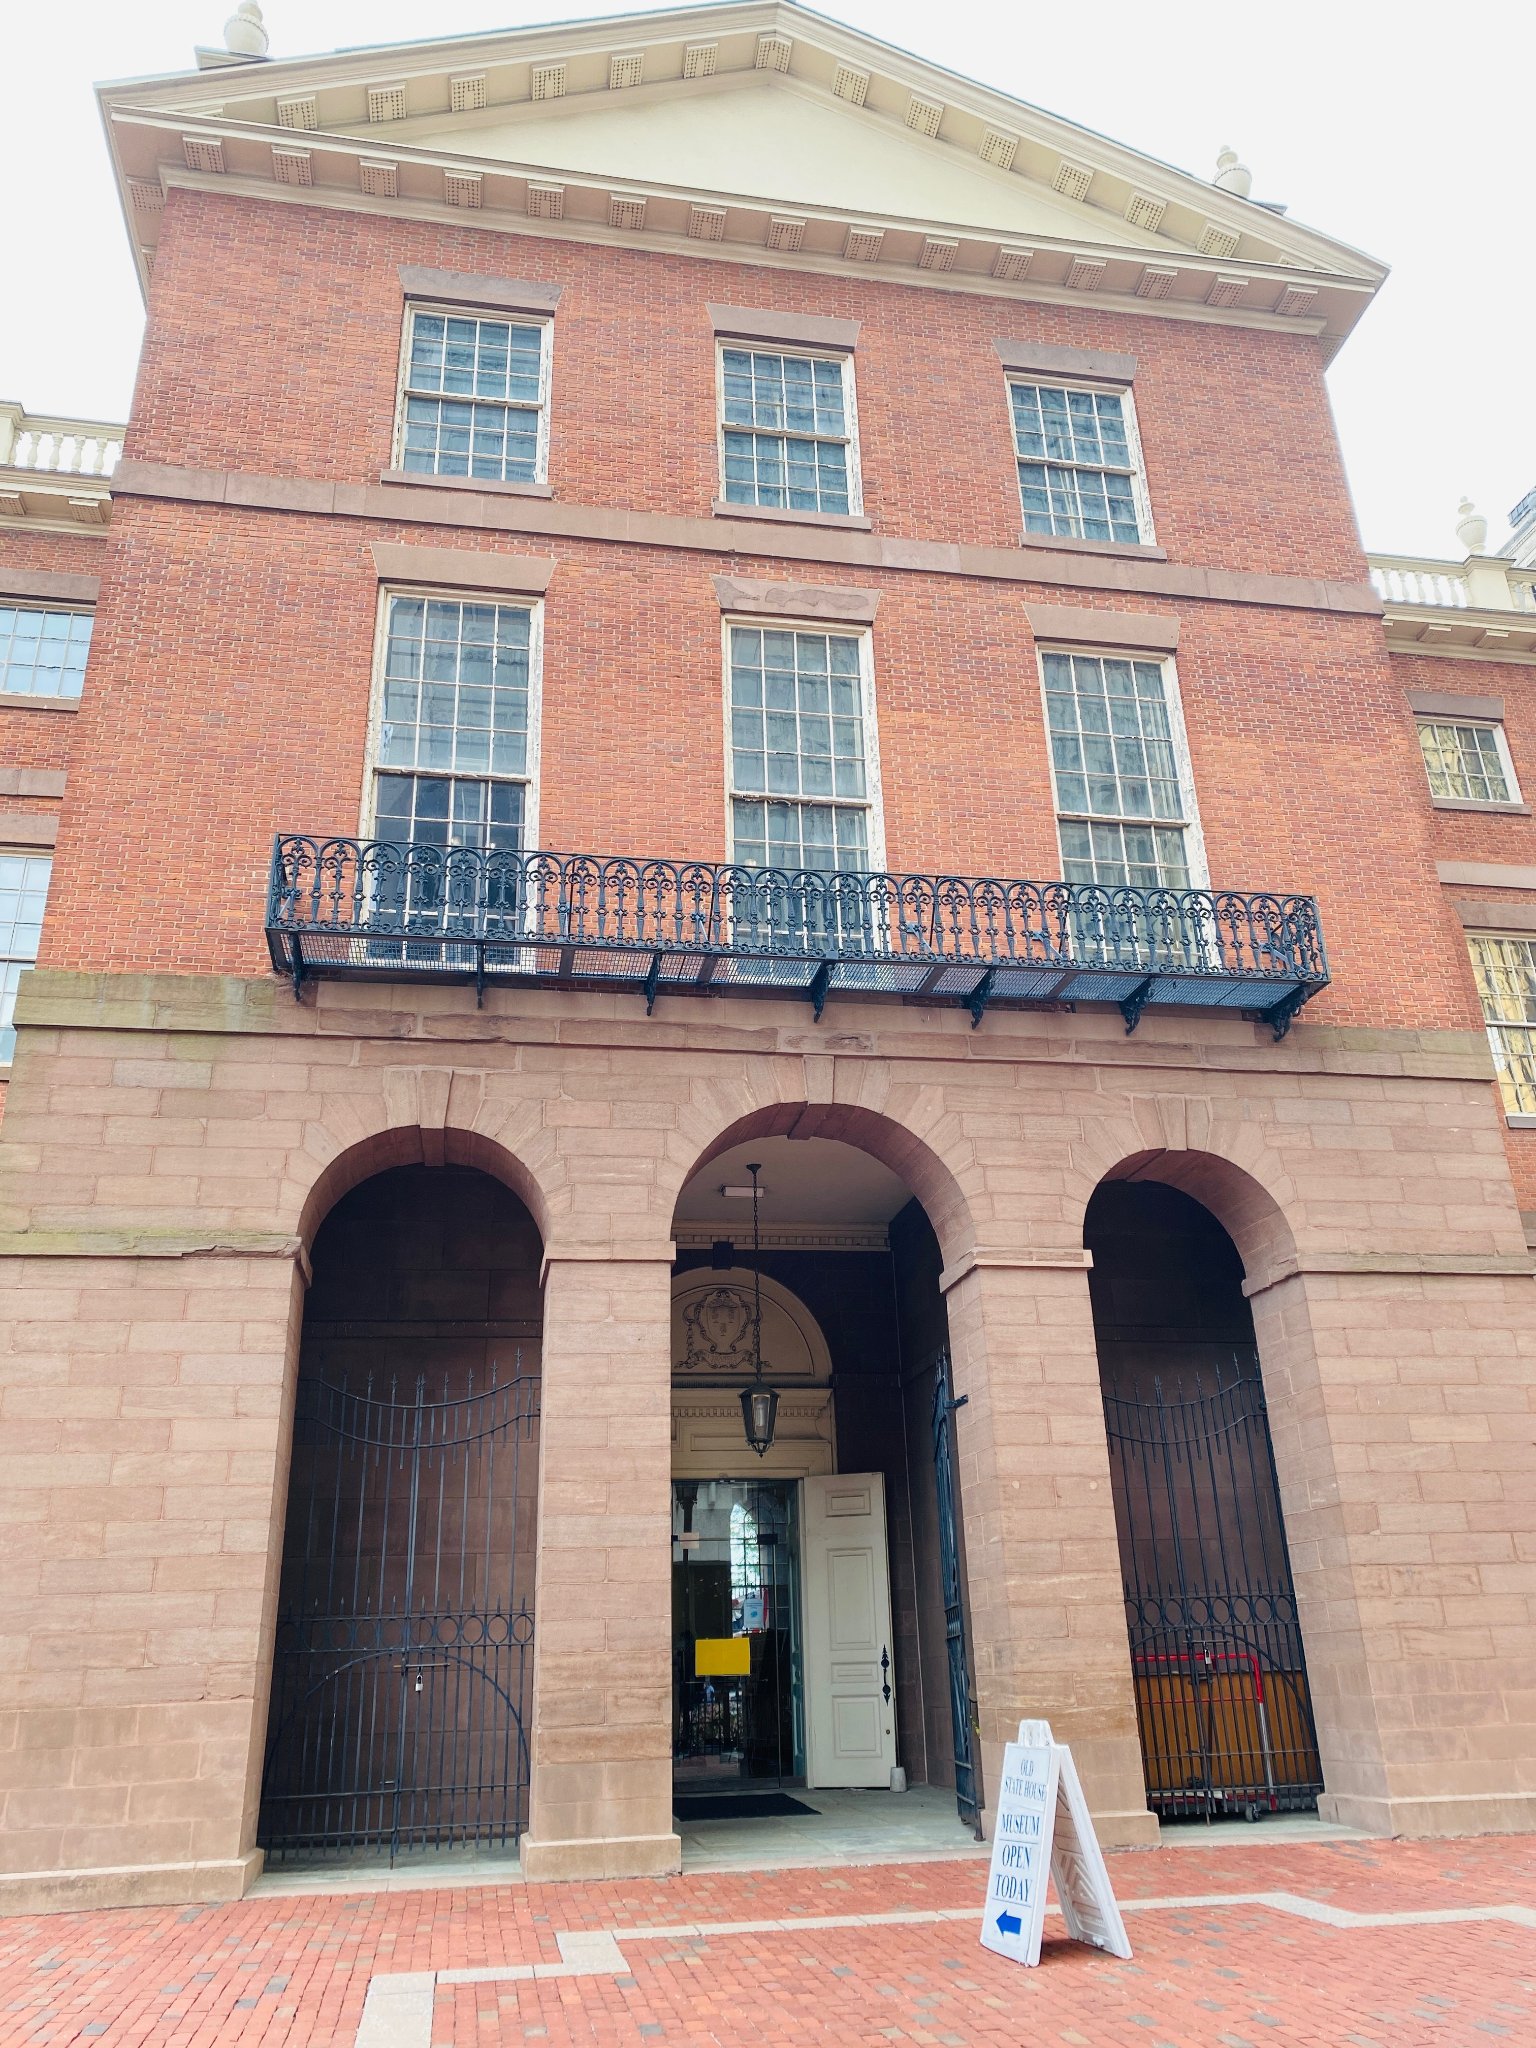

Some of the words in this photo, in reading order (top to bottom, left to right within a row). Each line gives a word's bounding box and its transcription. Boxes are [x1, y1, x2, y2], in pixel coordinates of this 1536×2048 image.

[1020, 1759, 1034, 1776] OLD
[1004, 1776, 1023, 1796] STATE
[1024, 1780, 1046, 1801] HOUSE
[1001, 1813, 1040, 1836] MUSEUM
[1002, 1844, 1032, 1869] OPEN
[995, 1874, 1033, 1902] TODAY
